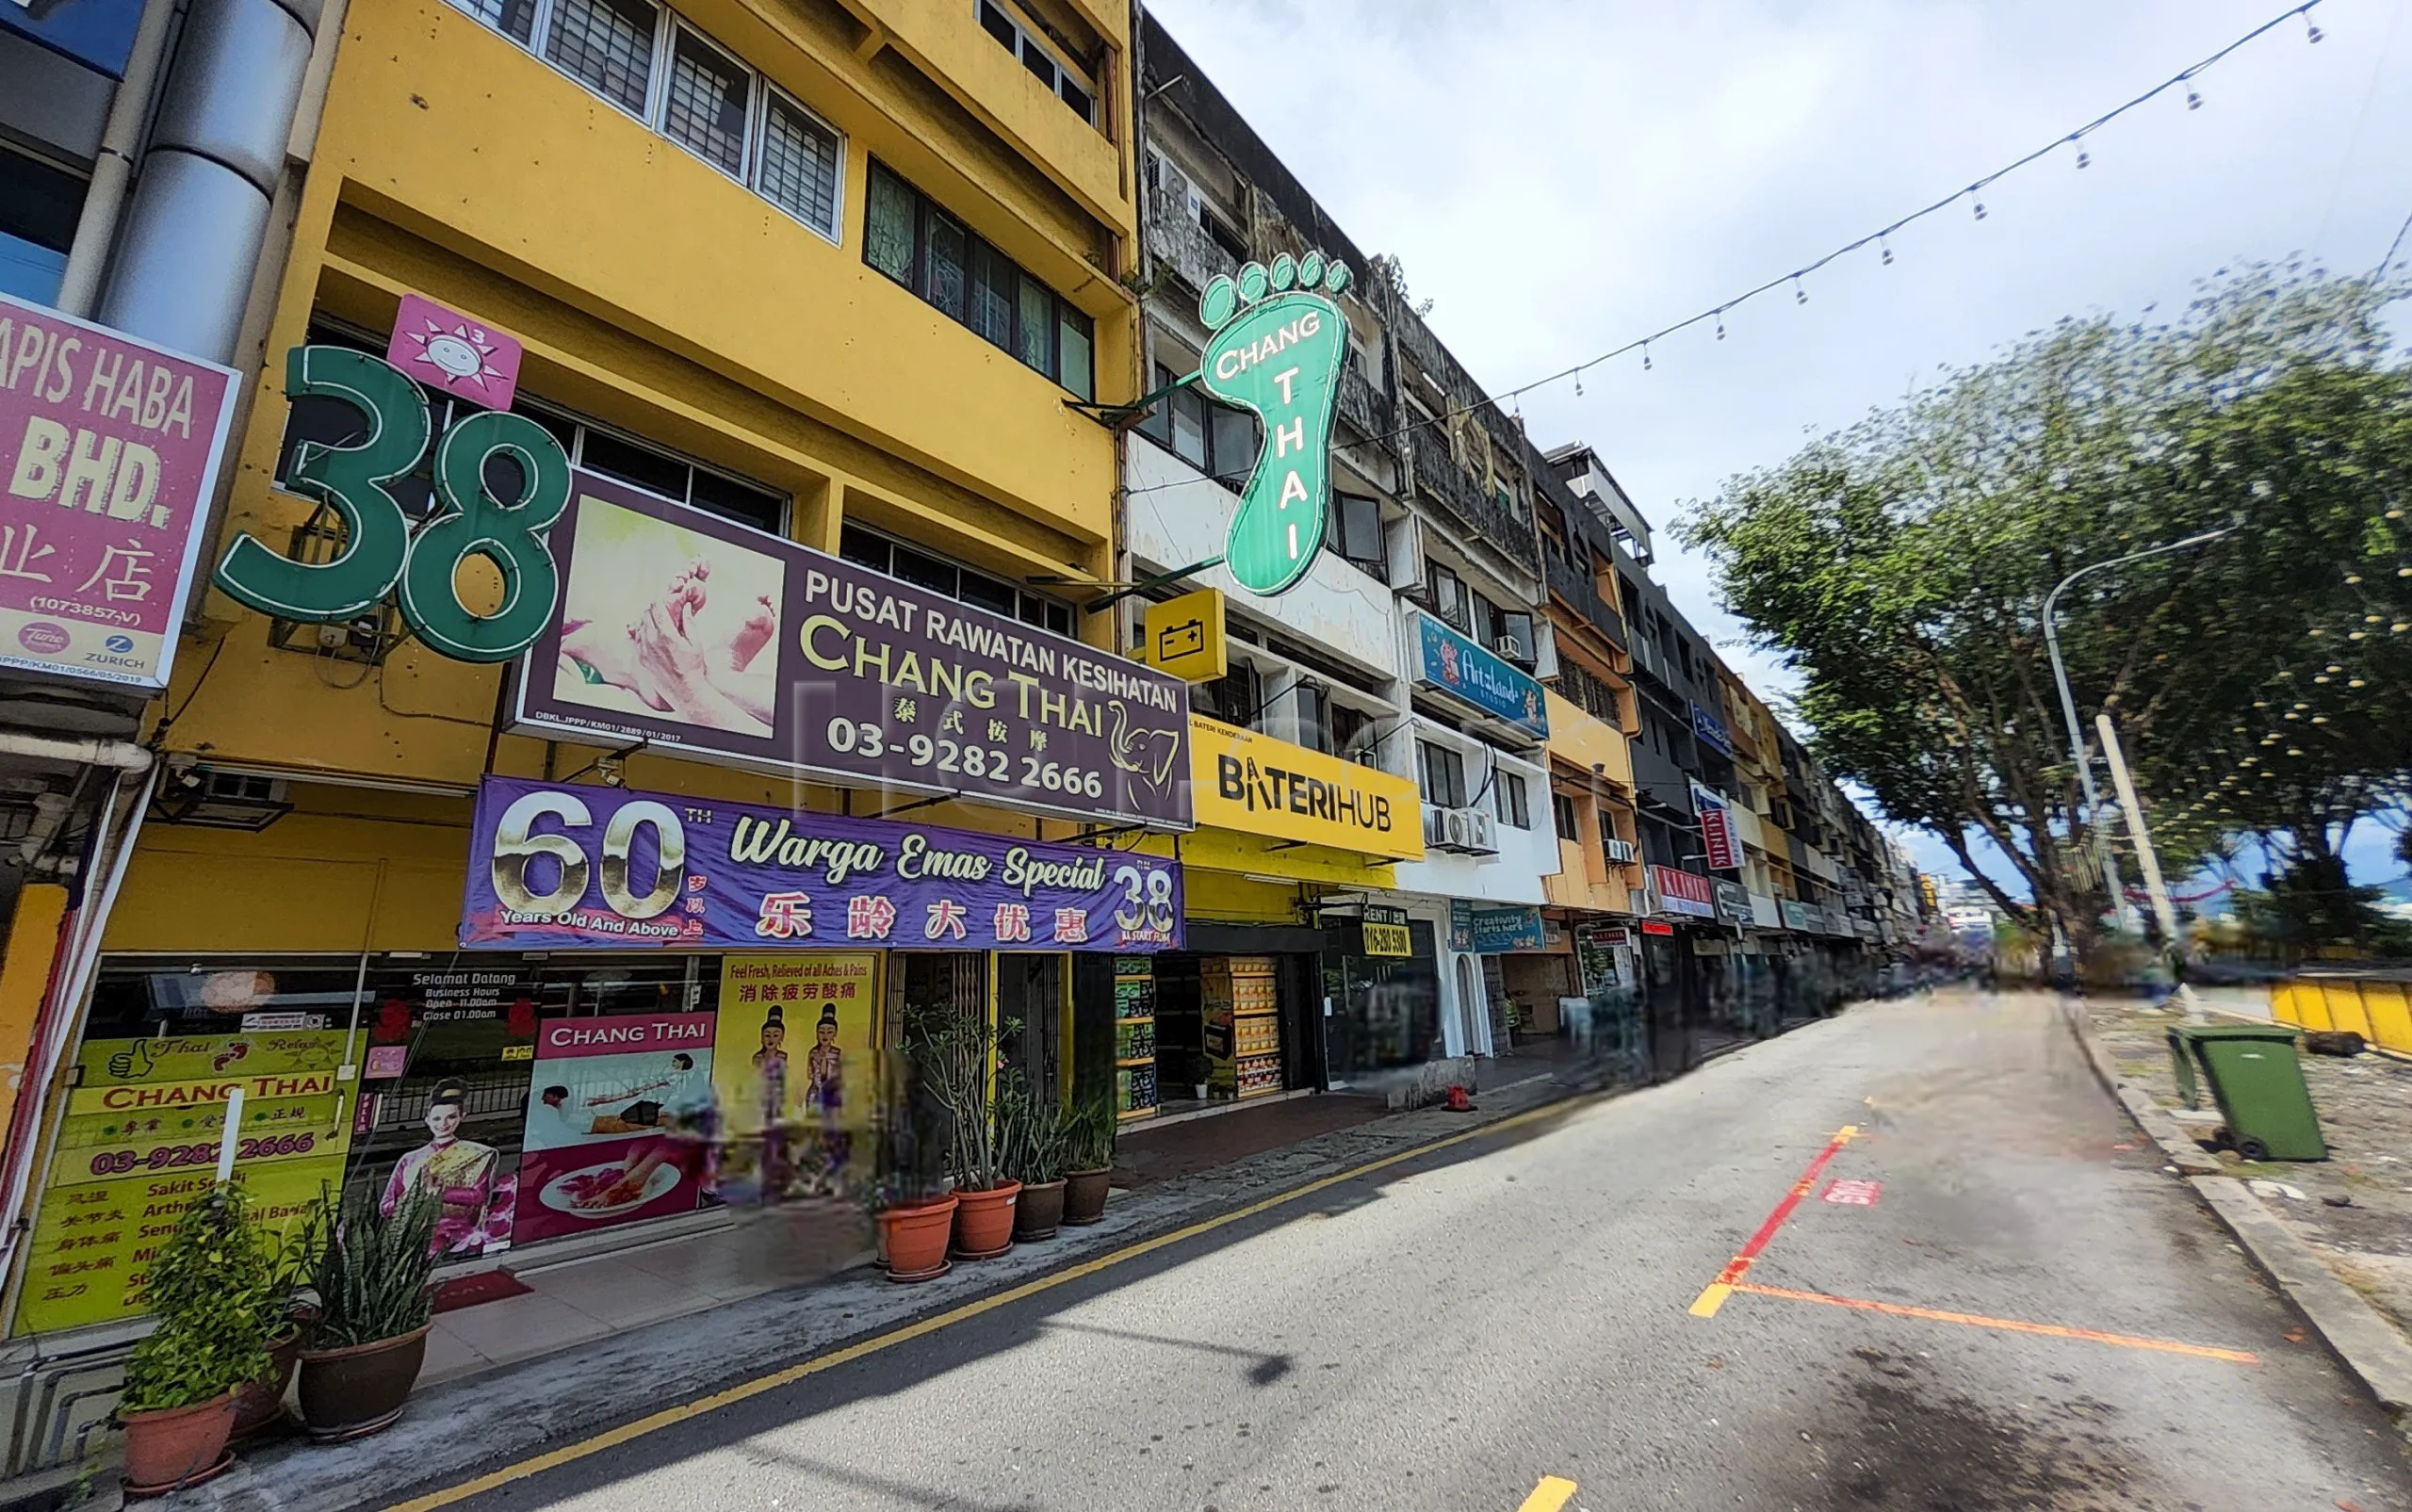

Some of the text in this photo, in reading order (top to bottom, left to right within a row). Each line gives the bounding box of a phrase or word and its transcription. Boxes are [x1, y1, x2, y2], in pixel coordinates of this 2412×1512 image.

[1215, 310, 1322, 381] CHANG
[81, 348, 194, 439] HABA
[8, 415, 171, 529] BHD.
[1274, 366, 1308, 560] THAI
[211, 345, 573, 664] 38
[805, 569, 1178, 714] PUSAT RAWATAN KESIHATAN
[84, 652, 145, 669] ZURICH
[800, 614, 1102, 738] CHANG THAI
[826, 716, 1102, 798] 03-9282 2666
[1218, 754, 1392, 832] BATERIHUB
[492, 790, 686, 919] 60
[730, 815, 1106, 896] Warga Emas Special
[1114, 866, 1174, 933] 38
[1662, 870, 1712, 902] KLINIK
[499, 910, 679, 936] Years Old And Above
[755, 891, 1088, 942] 乐龄大优惠
[1364, 907, 1388, 922] RENT
[413, 973, 516, 985] Selamat Datang
[730, 965, 747, 979] Feel
[772, 964, 802, 978] Relieved
[802, 964, 812, 977] of
[812, 964, 822, 977] all
[822, 964, 842, 977] Aches
[850, 964, 868, 977] Pains
[425, 988, 500, 998] Business Hours
[425, 1000, 453, 1009] Open
[739, 983, 856, 1002] 消除疲劳酸痛
[423, 1010, 451, 1021] Close
[550, 1022, 706, 1048] CHANG THAI
[253, 1076, 331, 1097] THAI
[236, 1131, 315, 1160] 2666
[147, 1179, 194, 1197] Sakit
